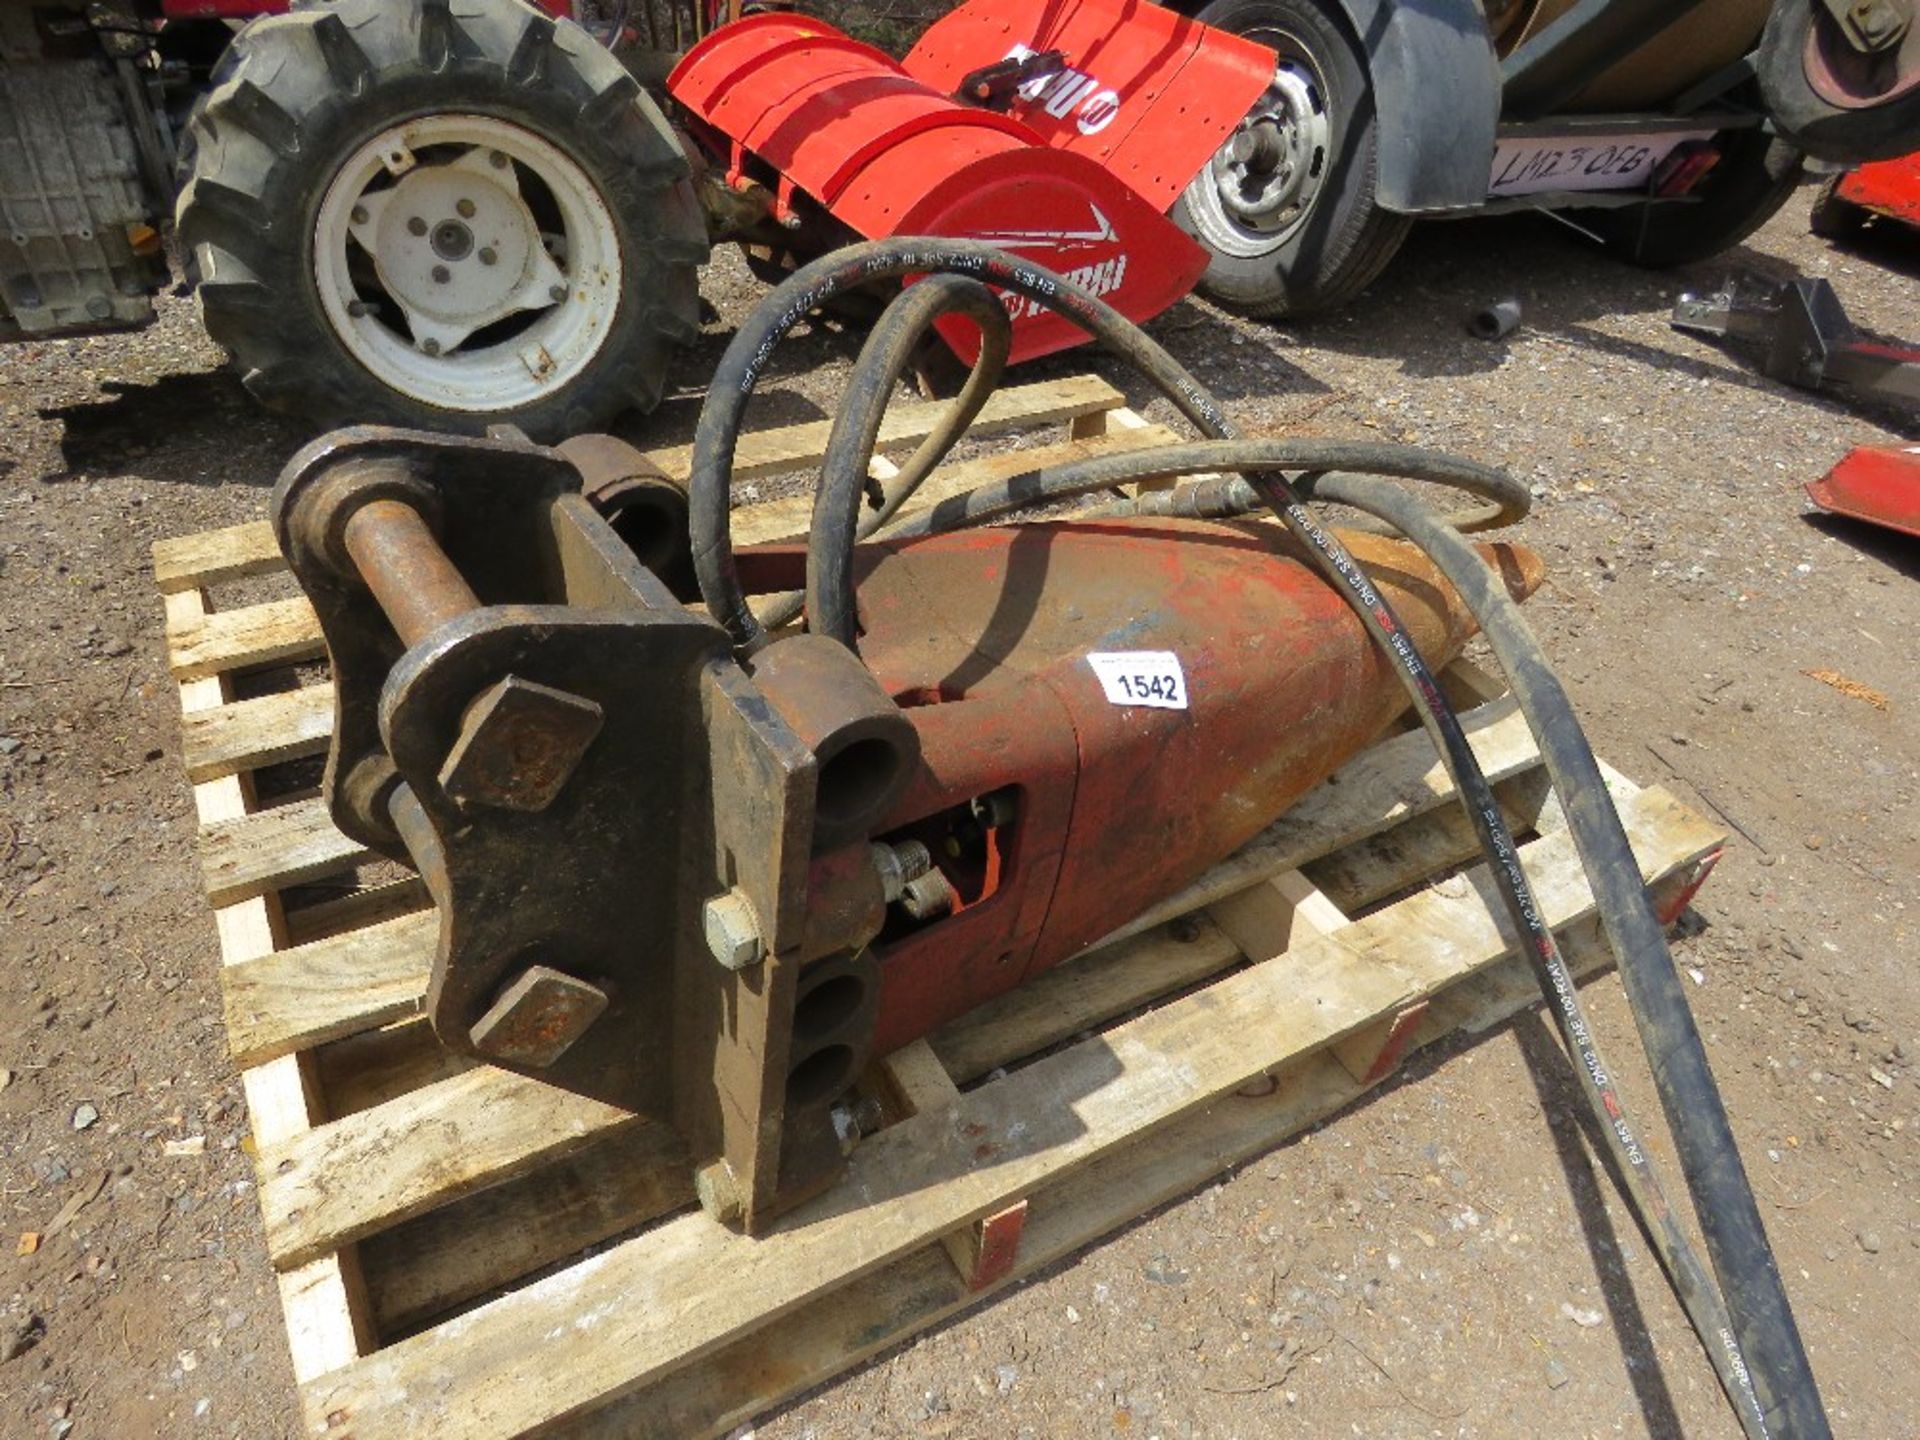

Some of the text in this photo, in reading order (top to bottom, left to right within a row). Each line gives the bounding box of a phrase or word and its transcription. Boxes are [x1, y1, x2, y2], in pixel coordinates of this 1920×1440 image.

[1329, 547, 1351, 573] SAE
[1348, 574, 1376, 605] DN12
[1118, 675, 1178, 701] 1542
[1568, 1018, 1590, 1046] SAE
[1584, 1050, 1606, 1085] DN12
[1624, 1142, 1645, 1166] EN
